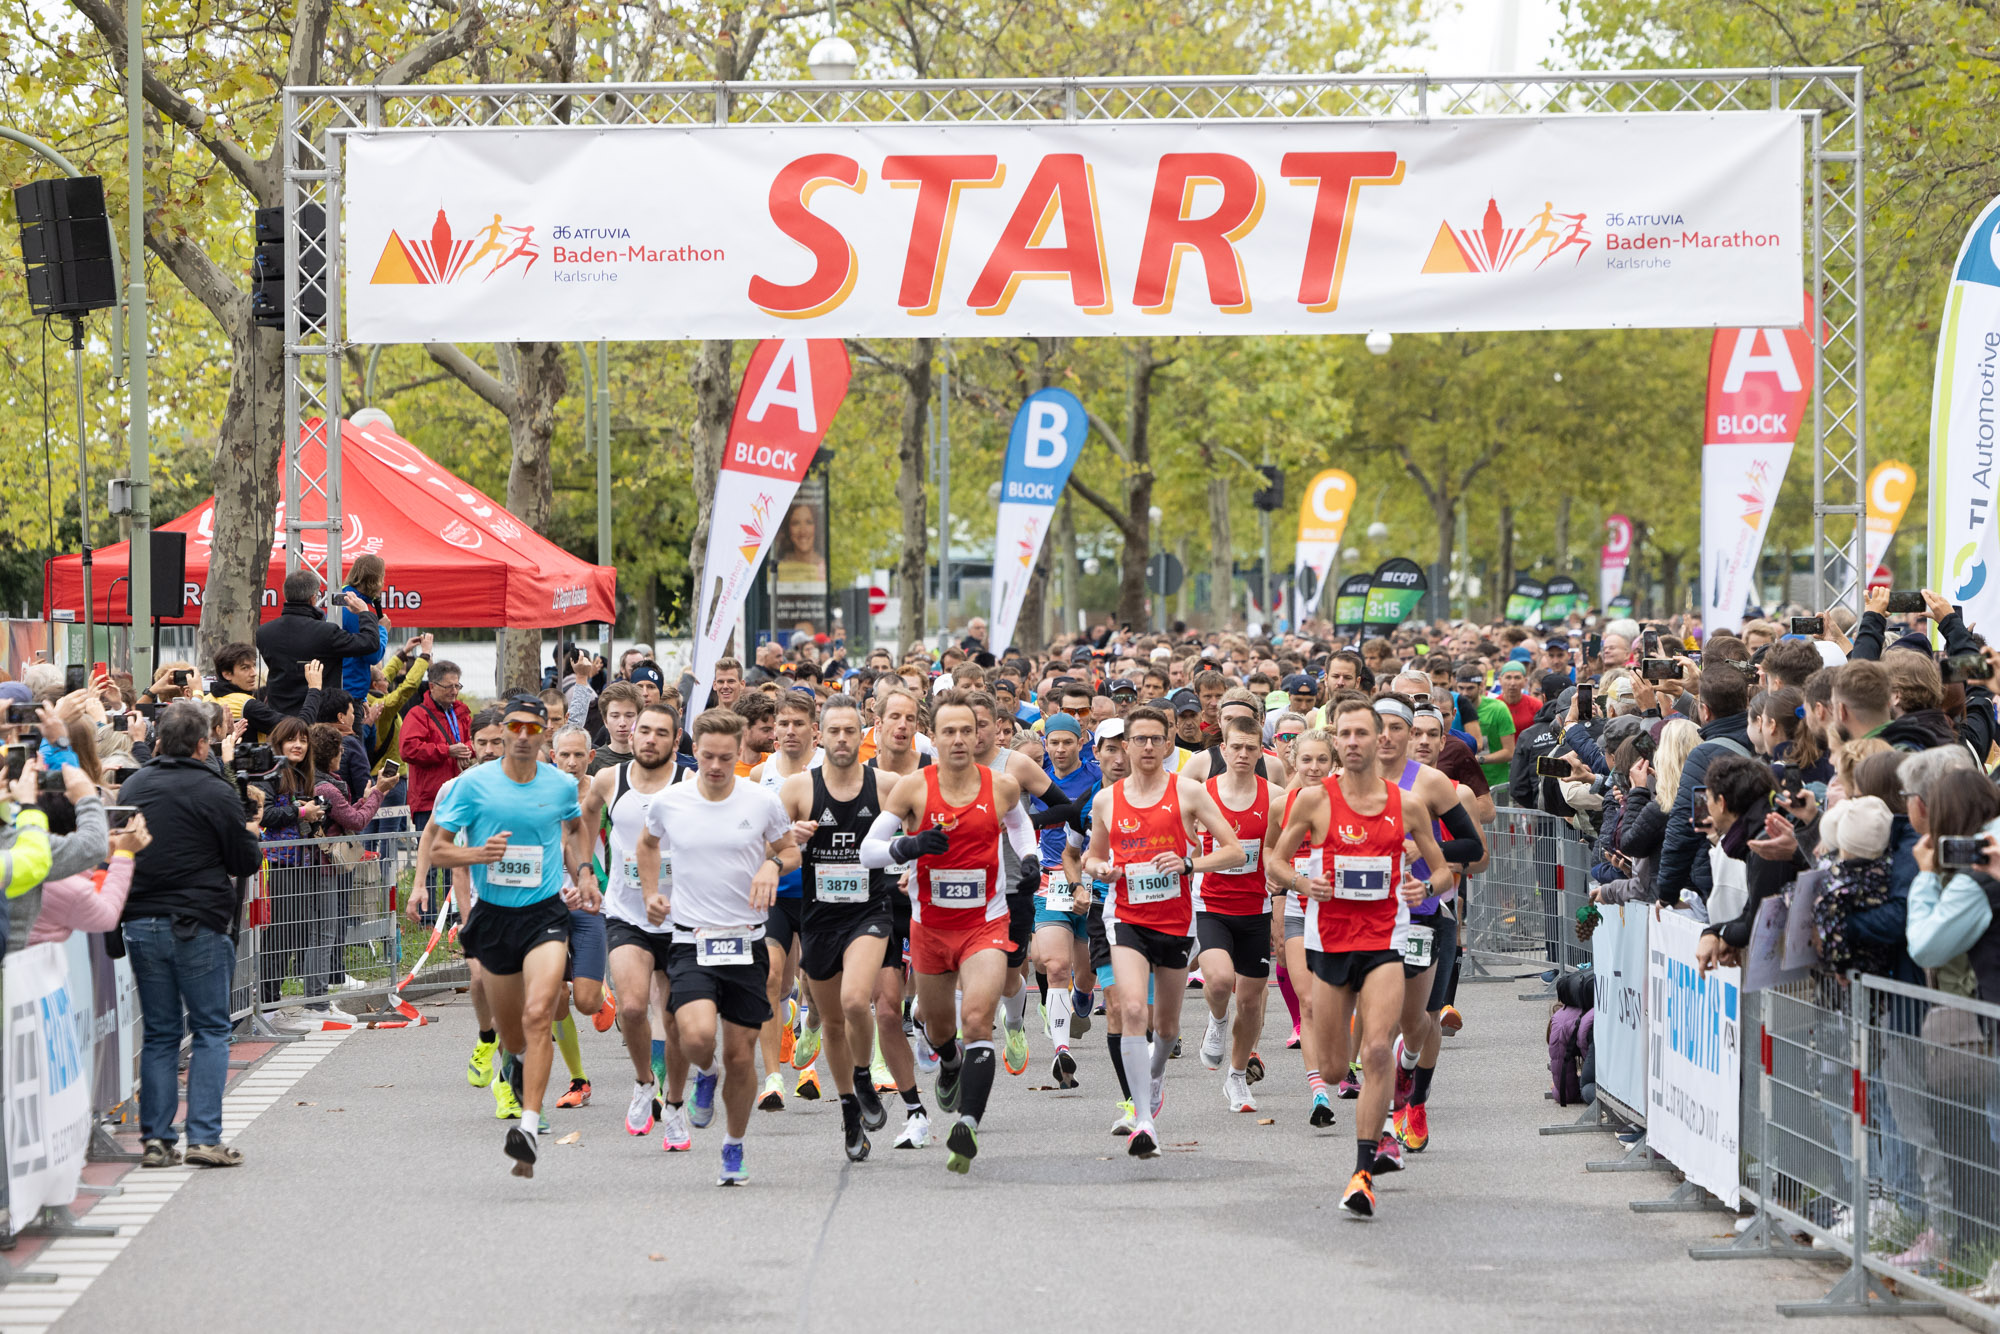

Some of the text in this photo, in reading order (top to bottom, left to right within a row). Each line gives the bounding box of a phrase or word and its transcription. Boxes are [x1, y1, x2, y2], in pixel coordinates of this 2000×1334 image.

[748, 151, 1405, 320] START
[1606, 230, 1780, 250] Baden-Marathon
[553, 245, 725, 263] Baden-Marathon
[1607, 257, 1672, 269] Karlsruhe
[554, 270, 618, 282] Karlsruhe
[1722, 328, 1802, 393] A
[747, 339, 817, 433] A
[1717, 413, 1787, 435] BLOCK
[1969, 331, 2000, 530] TI Automotive
[1024, 400, 1068, 469] B
[734, 442, 798, 472] BLOCK
[1008, 481, 1054, 500] BLOCK
[1871, 467, 1907, 514] C
[1312, 477, 1346, 522] C
[1393, 572, 1418, 586] cep
[1368, 600, 1400, 618] 3:15
[931, 813, 945, 822] LG
[1118, 818, 1129, 827] LG
[1338, 825, 1353, 834] LG
[1121, 837, 1148, 850] SWE
[498, 861, 530, 875] 3936
[827, 880, 858, 891] 3879
[1138, 876, 1170, 891] 1500
[1360, 873, 1367, 888] 1
[946, 884, 971, 897] 239
[711, 940, 737, 954] 202
